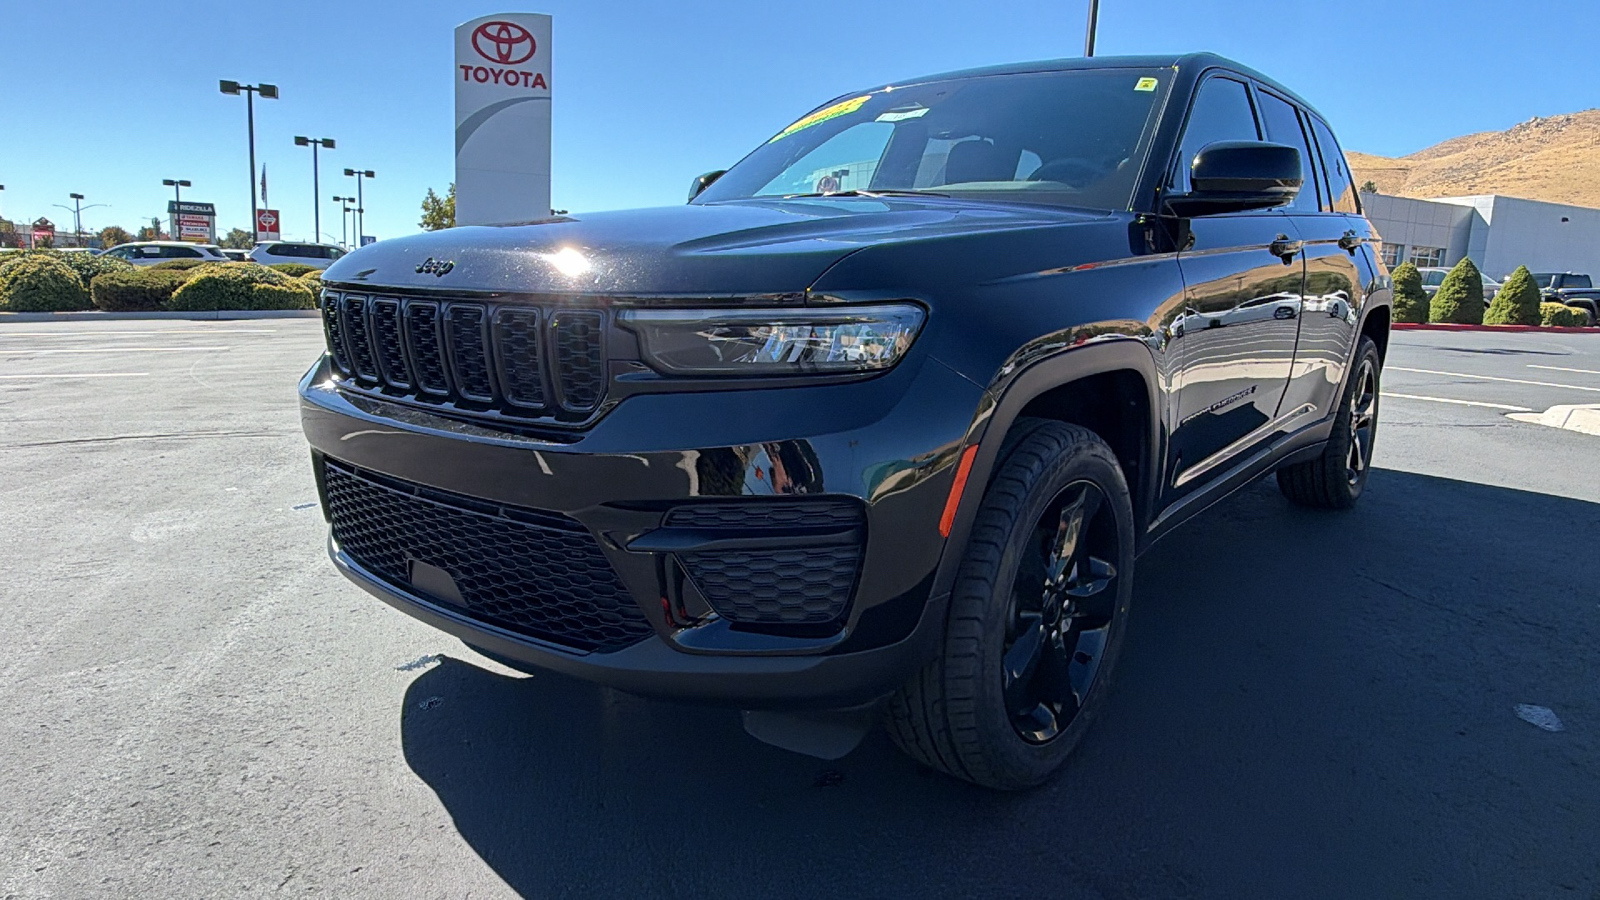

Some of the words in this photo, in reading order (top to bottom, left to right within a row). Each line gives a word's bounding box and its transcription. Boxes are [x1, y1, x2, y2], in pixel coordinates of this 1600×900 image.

[460, 65, 547, 90] TOYOTA
[180, 204, 213, 212] RIDEZILLA
[415, 257, 454, 278] Jeep
